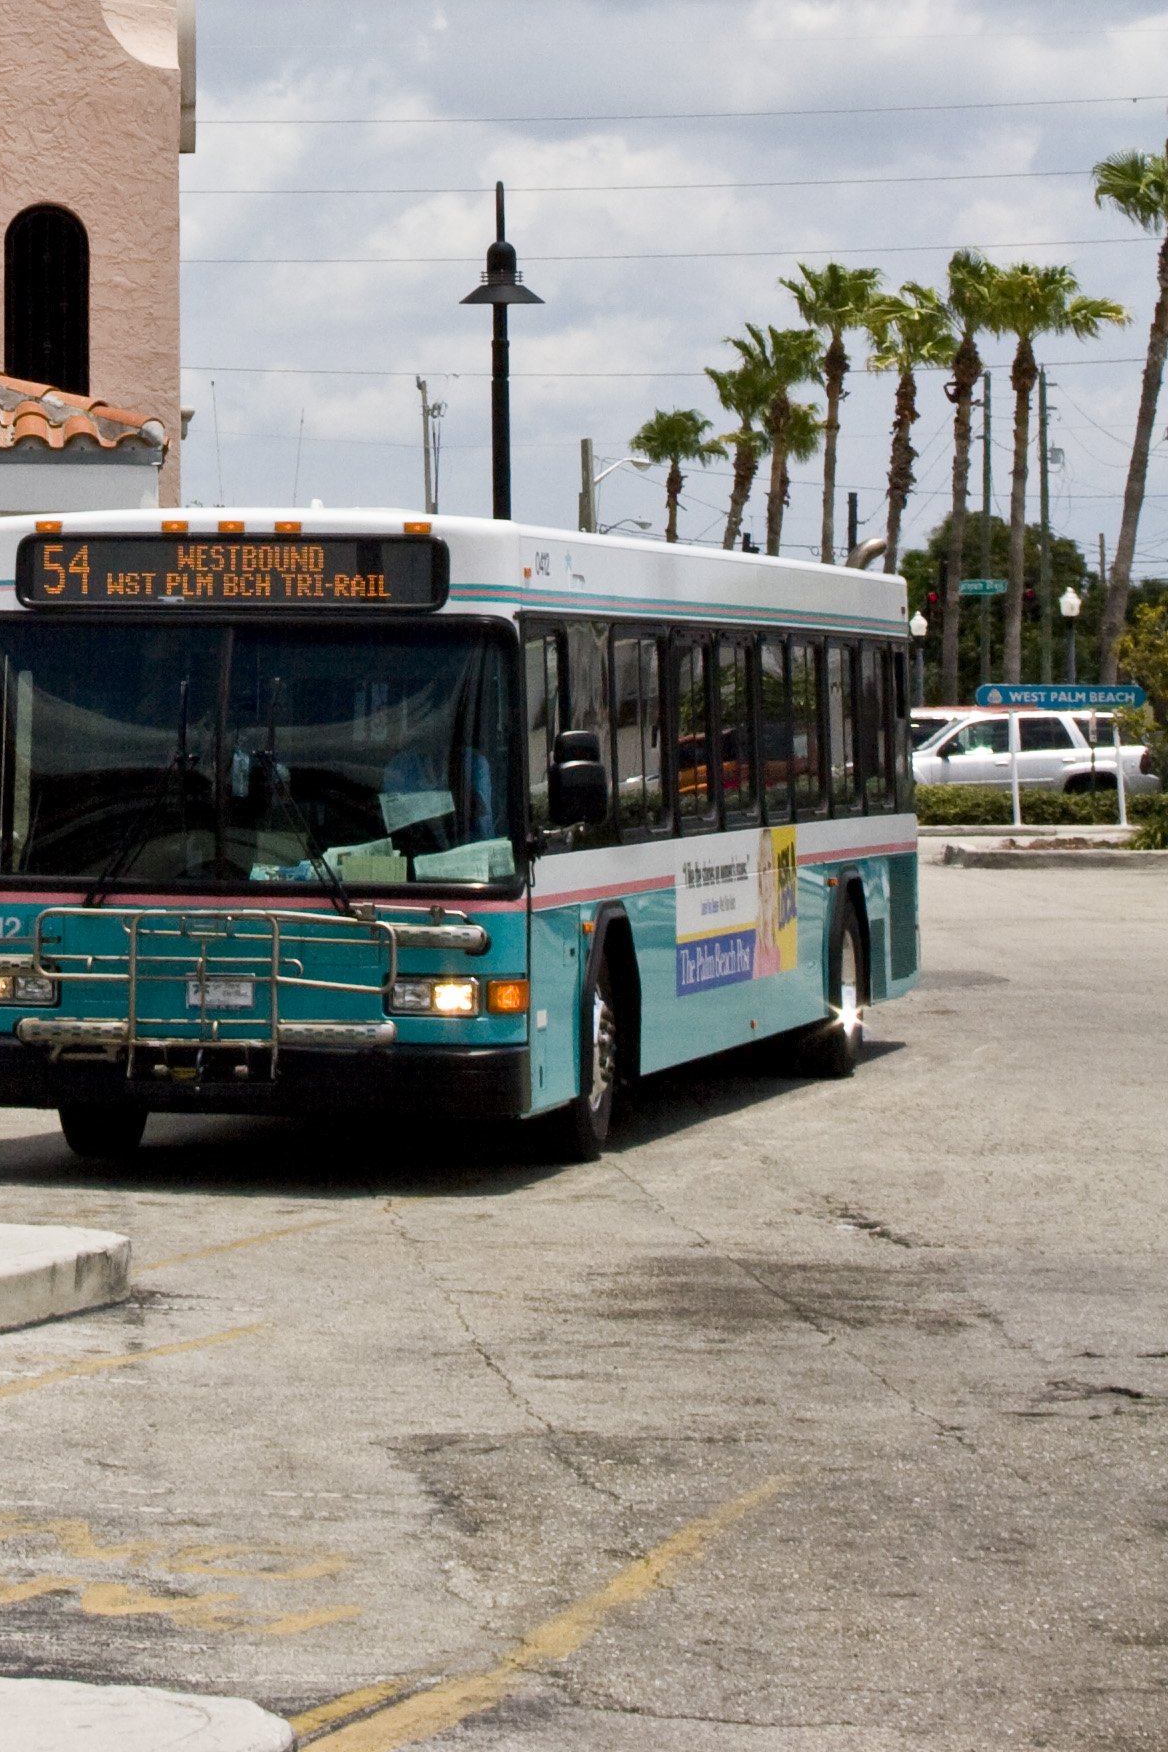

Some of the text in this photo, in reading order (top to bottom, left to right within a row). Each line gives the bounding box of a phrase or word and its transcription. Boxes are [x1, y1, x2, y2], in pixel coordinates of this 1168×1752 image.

[43, 545, 90, 595] 54
[177, 545, 324, 572] WESTBOUND
[107, 572, 391, 597] WST PLM BCH TRI-RAIL
[1009, 691, 1136, 704] WEST PALM BEACH
[680, 949, 696, 985] The
[696, 945, 715, 982] Palm
[715, 939, 736, 978] Beach
